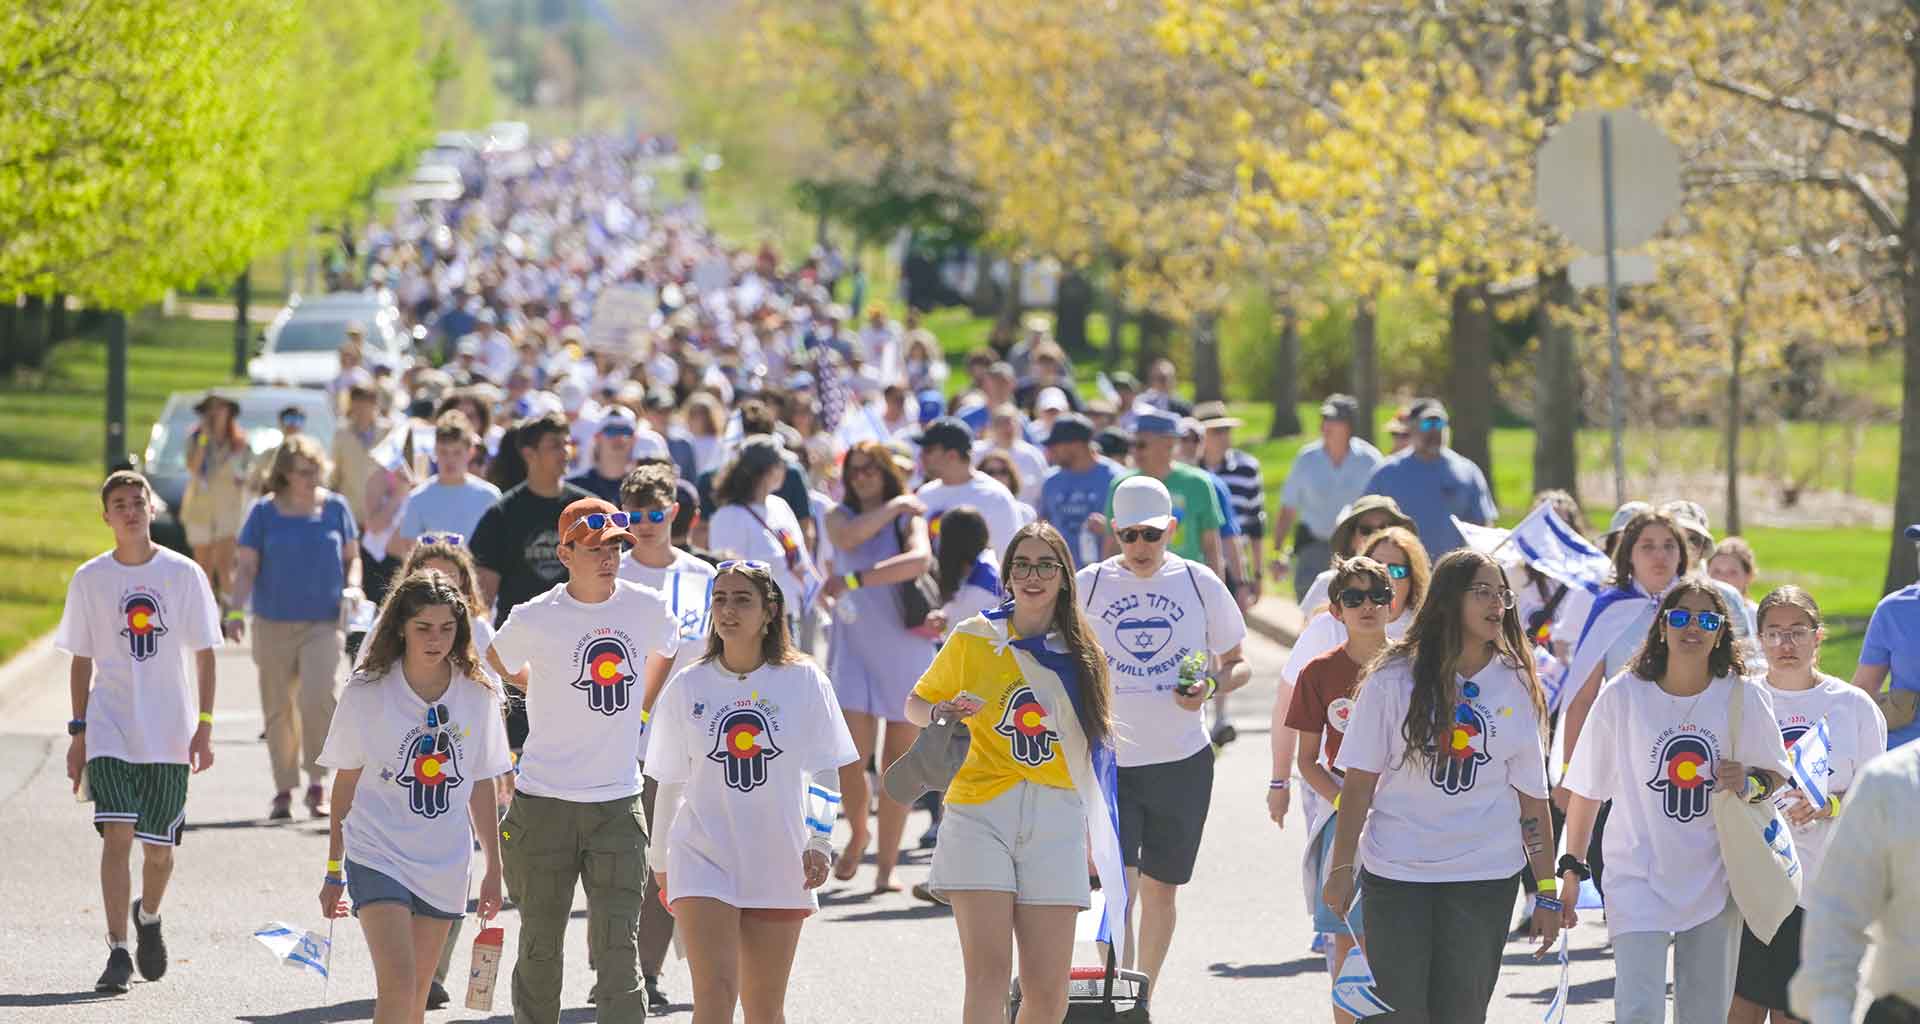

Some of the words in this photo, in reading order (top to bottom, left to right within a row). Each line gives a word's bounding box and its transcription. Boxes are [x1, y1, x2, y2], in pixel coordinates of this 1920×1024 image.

[1100, 594, 1139, 625] ננצח
[1146, 592, 1185, 622] ביחד
[576, 632, 592, 652] HERE
[614, 629, 632, 644] HERE
[1116, 663, 1145, 677] WILL
[714, 704, 731, 722] HERE
[403, 727, 421, 746] HERE
[1656, 728, 1674, 746] HERE
